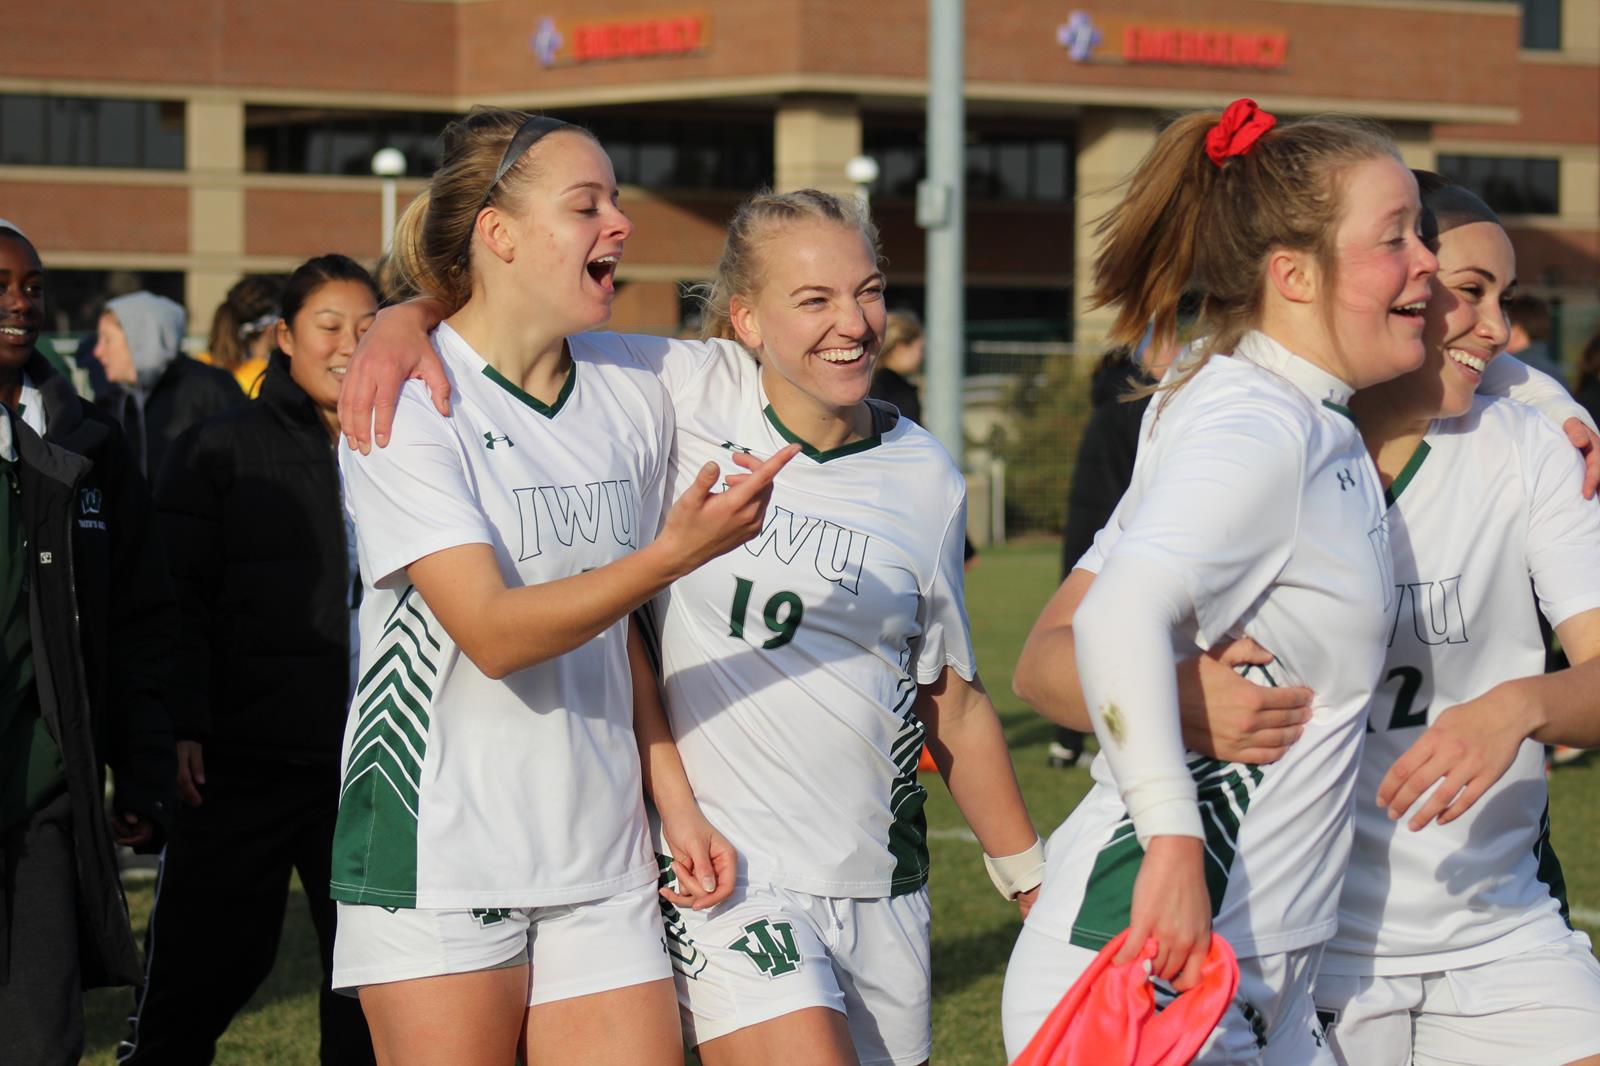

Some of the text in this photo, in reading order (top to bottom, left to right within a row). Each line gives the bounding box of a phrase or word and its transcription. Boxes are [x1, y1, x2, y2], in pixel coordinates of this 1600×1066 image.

[1123, 25, 1287, 69] EMERGENCY
[512, 479, 637, 562] IWU
[723, 483, 870, 596] WU
[726, 573, 804, 650] 19
[1366, 665, 1429, 734] 2
